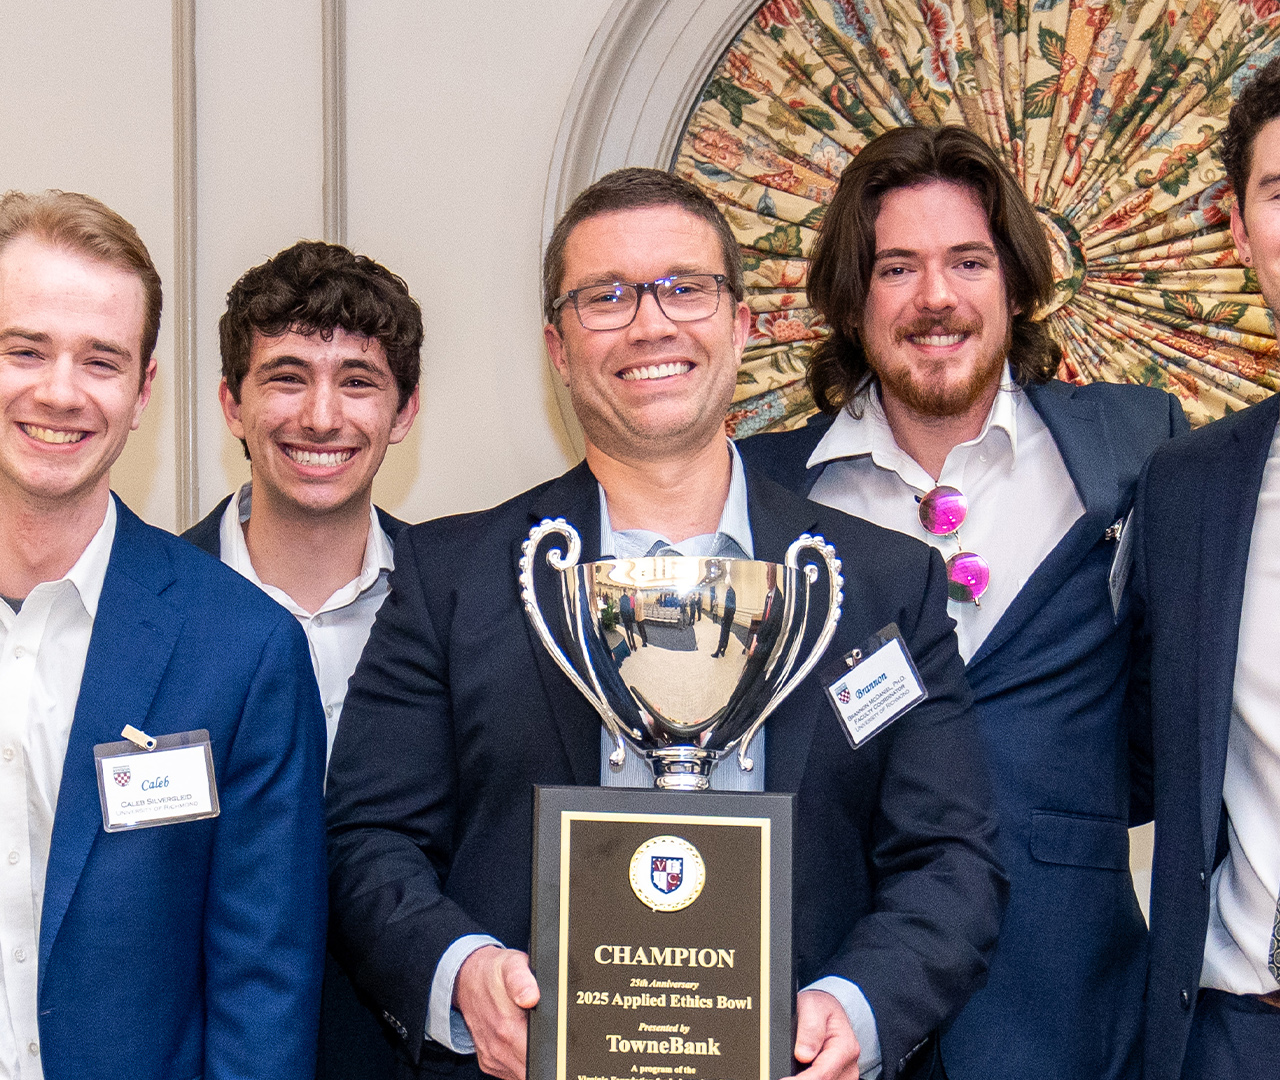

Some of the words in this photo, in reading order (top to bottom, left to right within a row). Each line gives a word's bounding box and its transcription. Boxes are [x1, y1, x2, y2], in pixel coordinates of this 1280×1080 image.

[855, 673, 887, 699] Brannon
[847, 703, 870, 722] BRANNON
[853, 708, 874, 725] FACULTY
[873, 684, 906, 709] COORDINATOR
[141, 776, 170, 791] Caleb
[120, 800, 145, 808] CALEB
[594, 945, 735, 968] CHAMPION
[630, 978, 648, 988] 25th
[649, 979, 699, 991] Anniversary
[576, 991, 609, 1005] 2025
[612, 993, 666, 1009] Applied
[670, 994, 713, 1008] Ethics
[716, 996, 752, 1010] Bowl
[638, 1023, 679, 1033] Presented
[680, 1024, 690, 1034] by
[606, 1034, 721, 1055] TowneBank
[631, 1065, 638, 1073] A
[640, 1066, 672, 1075] program
[674, 1066, 683, 1074] of
[683, 1066, 696, 1074] the
